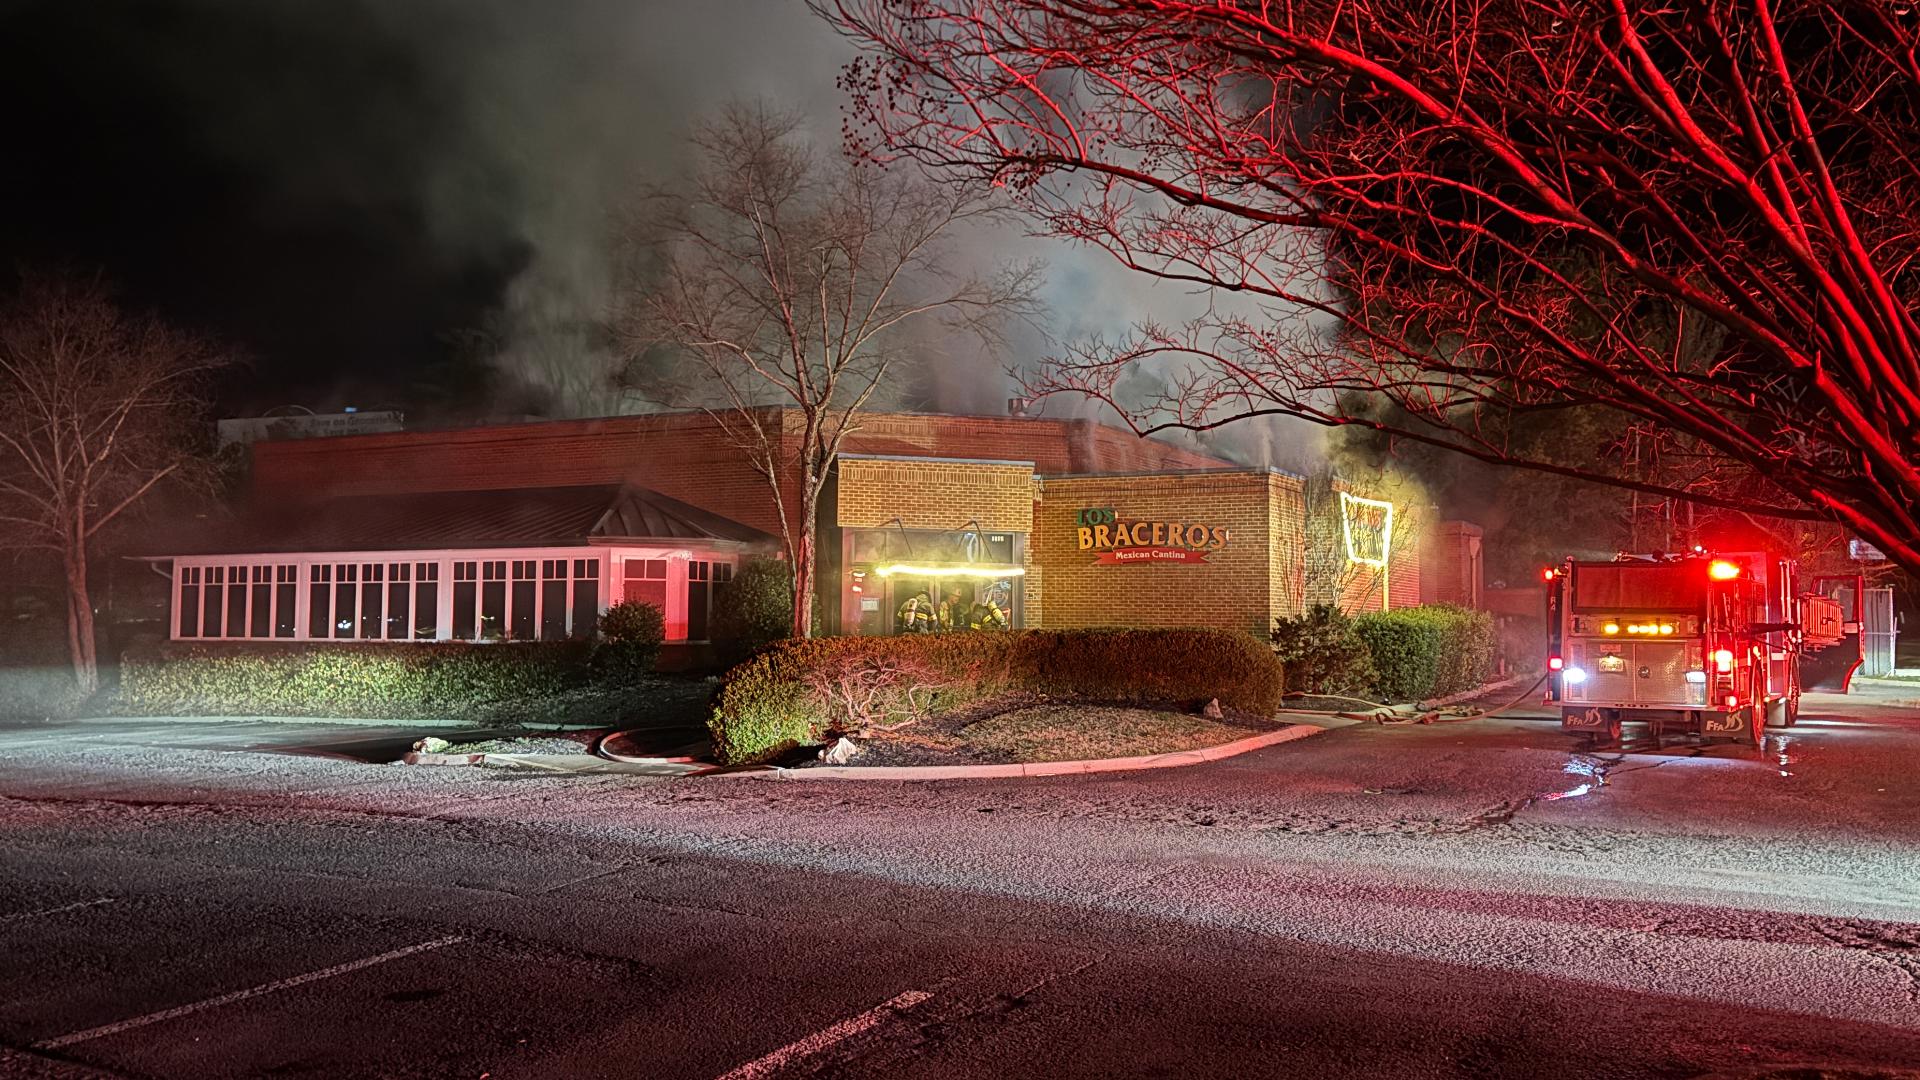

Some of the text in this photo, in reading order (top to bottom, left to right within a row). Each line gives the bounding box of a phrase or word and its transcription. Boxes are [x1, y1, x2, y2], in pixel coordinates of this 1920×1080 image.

[1077, 522, 1228, 550] BRACEROS
[1115, 550, 1186, 560] Mexican Cantina
[1567, 714, 1583, 726] FFA
[1705, 720, 1724, 732] FFA
